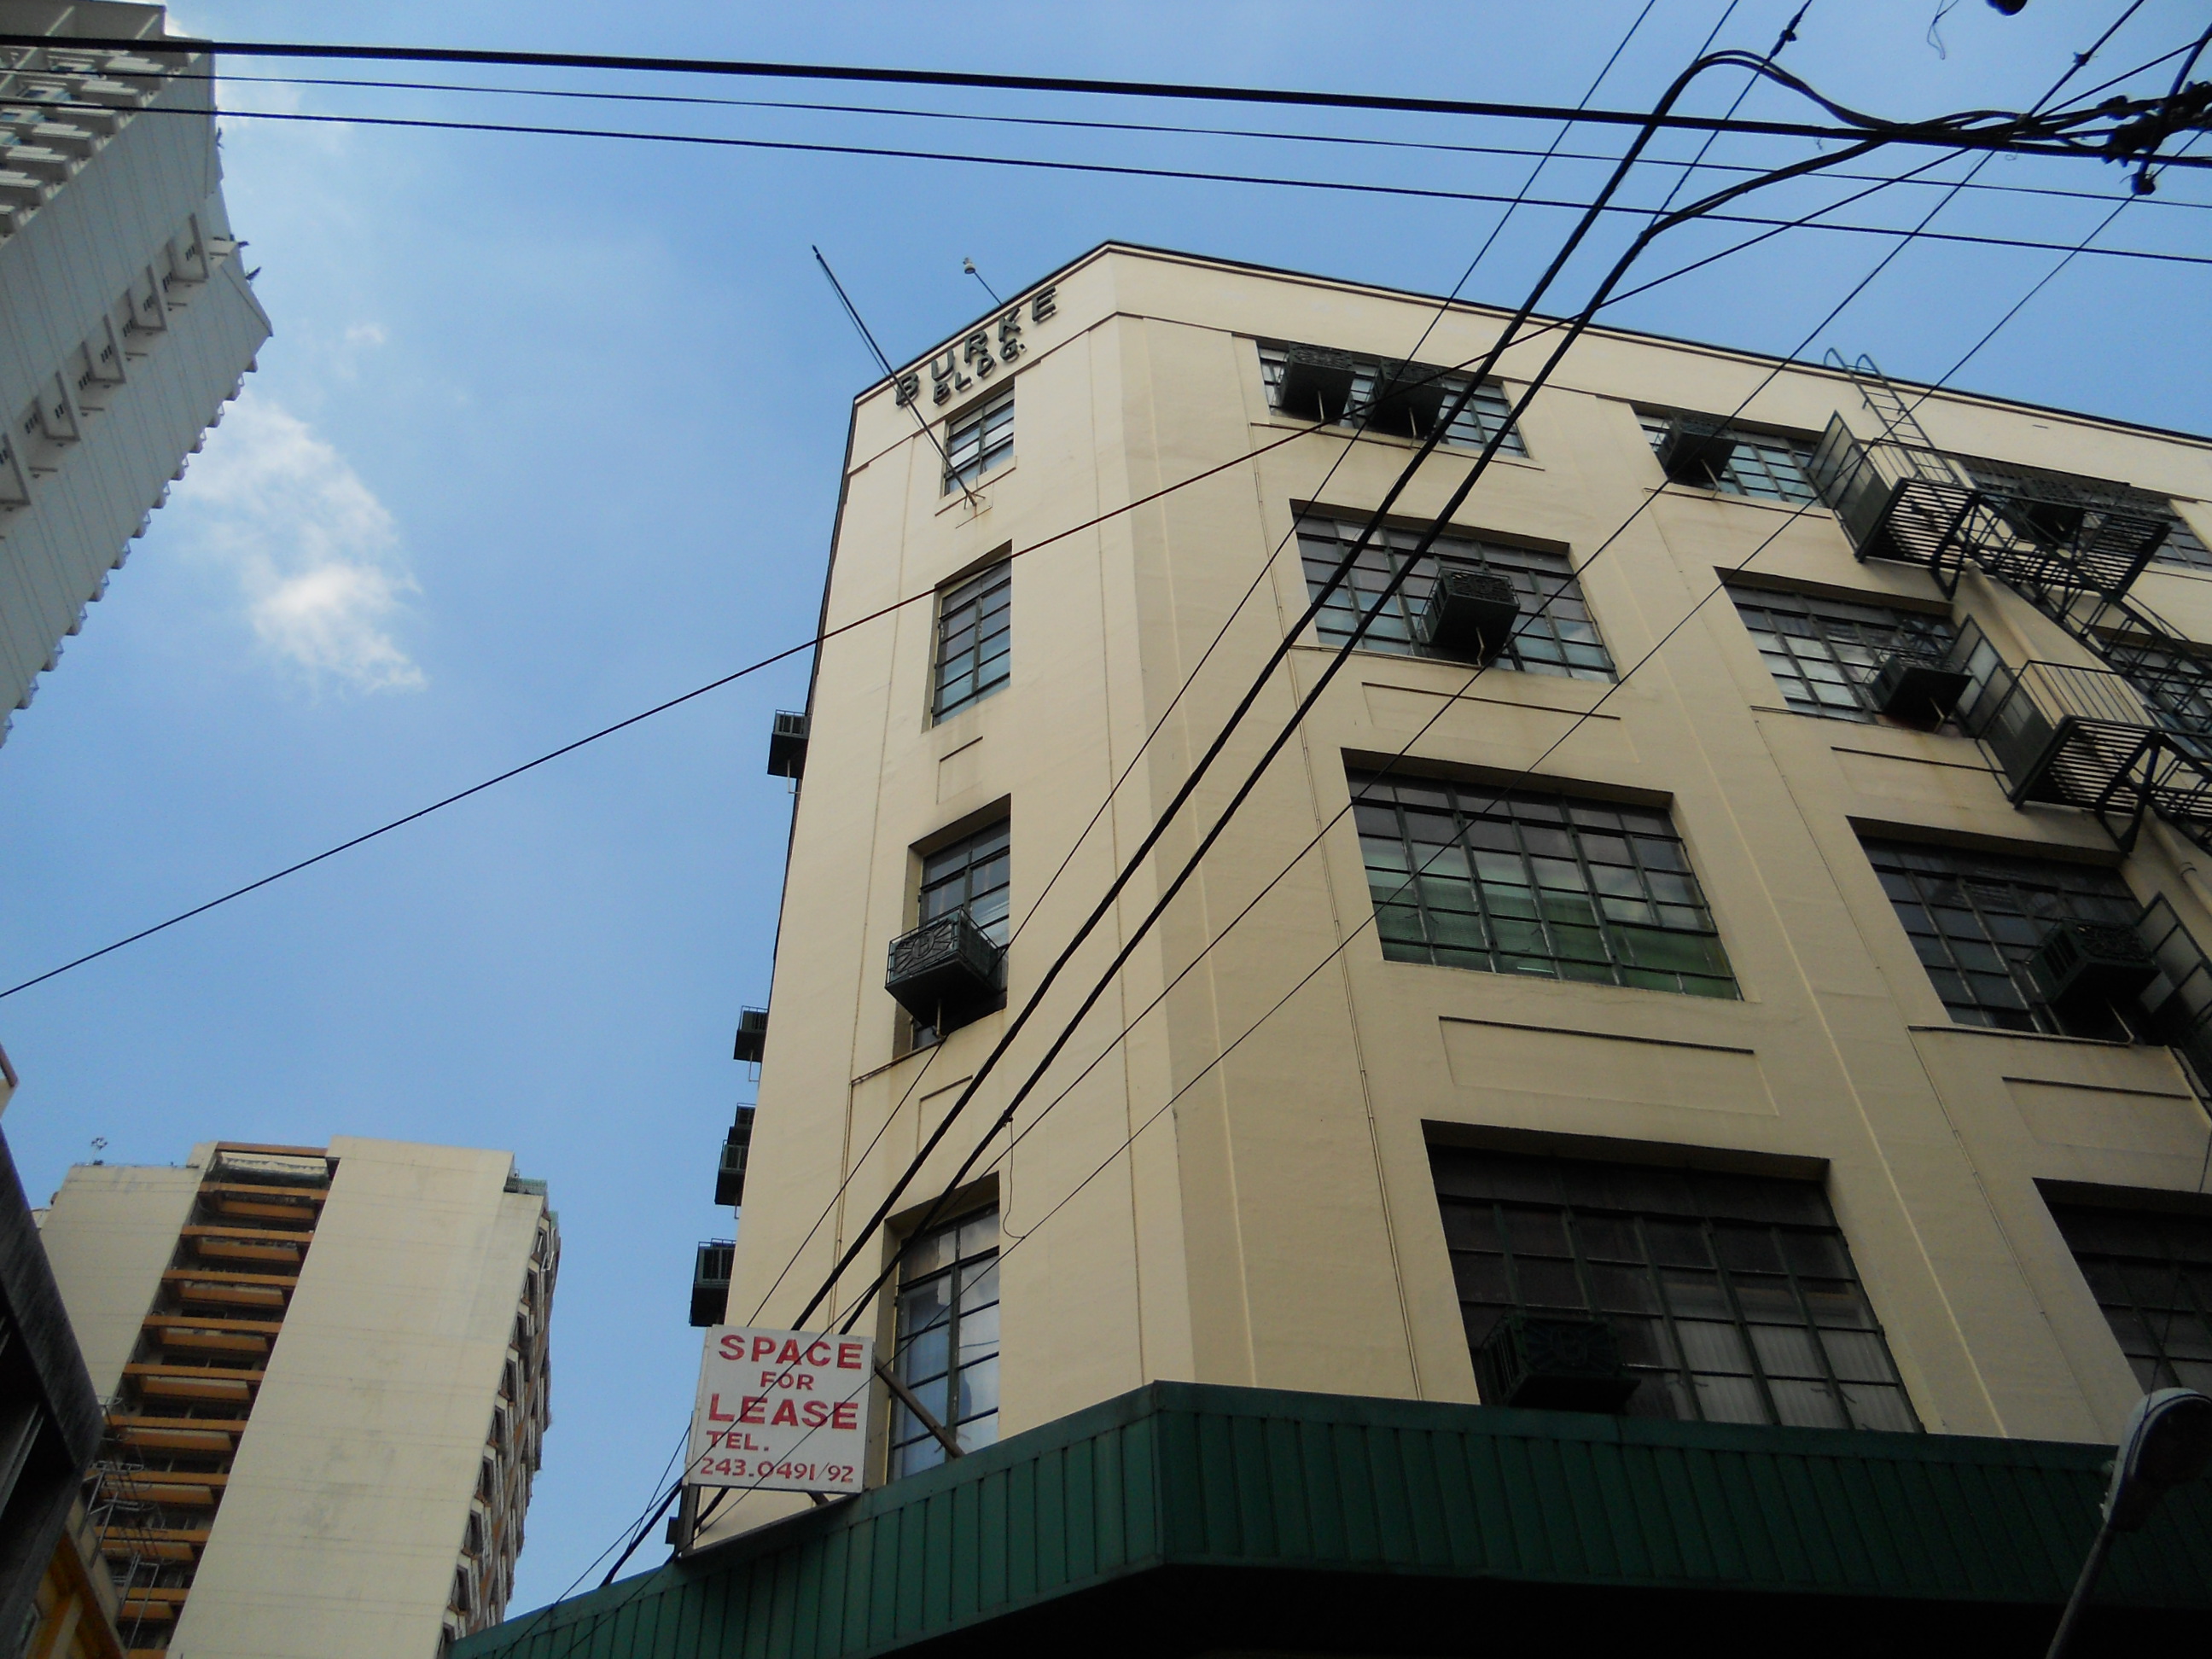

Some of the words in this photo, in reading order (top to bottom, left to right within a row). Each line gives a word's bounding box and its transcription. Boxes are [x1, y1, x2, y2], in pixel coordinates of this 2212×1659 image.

[896, 285, 1057, 405] BURKE
[933, 338, 1027, 405] BLDG.
[719, 1334, 864, 1370] SPACE
[760, 1371, 814, 1390] FOR
[708, 1393, 859, 1429] LEASE
[706, 1430, 770, 1452] TEL.
[700, 1457, 854, 1483] 243.0491/92
